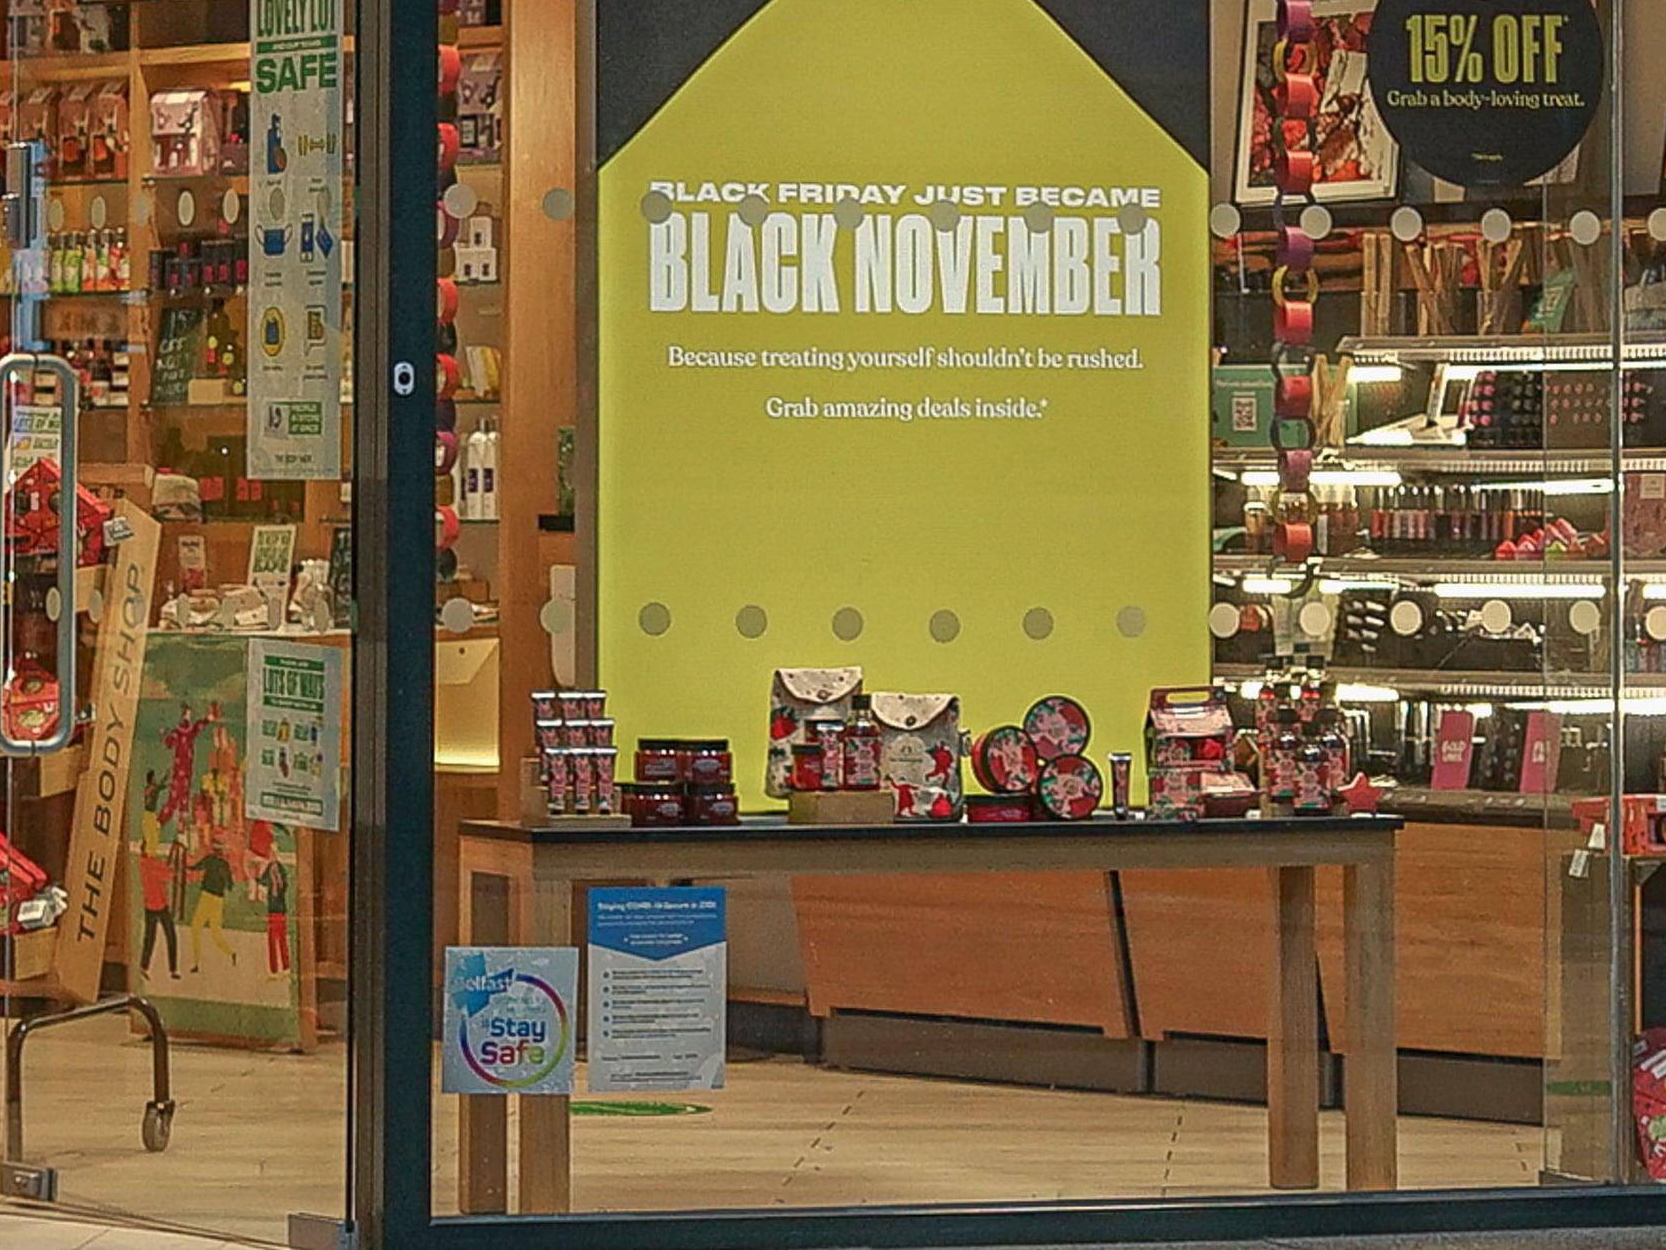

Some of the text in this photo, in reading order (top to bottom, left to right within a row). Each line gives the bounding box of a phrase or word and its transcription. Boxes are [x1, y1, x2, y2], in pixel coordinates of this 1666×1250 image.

[1405, 14, 1483, 83] 15%
[256, 52, 338, 93] SAFE
[1387, 90, 1585, 109] Grab a body-loving treat.
[650, 182, 1161, 207] BLACK FRIDAY JUST BECAME
[650, 211, 1161, 316] BLACK NOVEMBER
[668, 346, 1144, 372] Because treating yourself shouldn't be rushed.
[765, 396, 818, 418] Grab
[823, 398, 913, 421] amazing
[918, 396, 971, 418] deals
[77, 562, 146, 943] THE BODY SHOP
[480, 1041, 546, 1066] Safe
